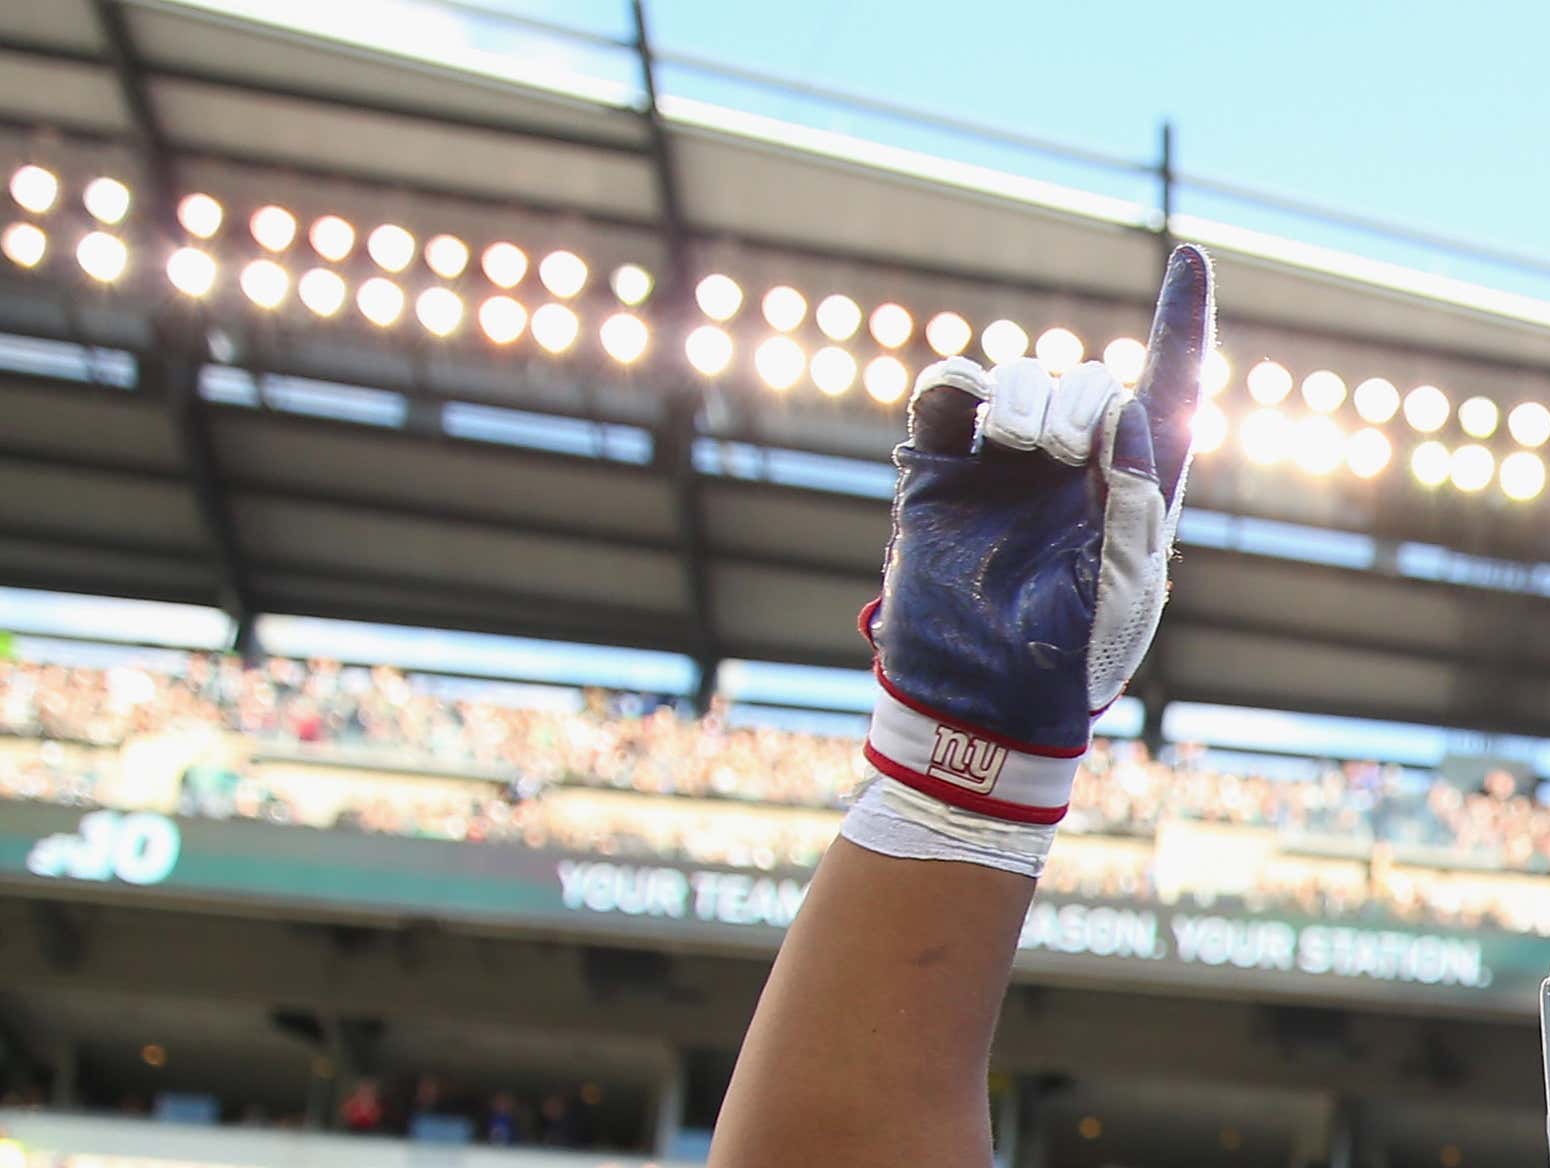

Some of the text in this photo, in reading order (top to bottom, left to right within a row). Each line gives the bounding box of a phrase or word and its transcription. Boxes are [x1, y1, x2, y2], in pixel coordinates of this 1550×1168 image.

[927, 724, 1007, 795] ny
[557, 859, 690, 919] YOUR
[1170, 913, 1296, 971] YOUR
[1297, 924, 1493, 989] STATION.
